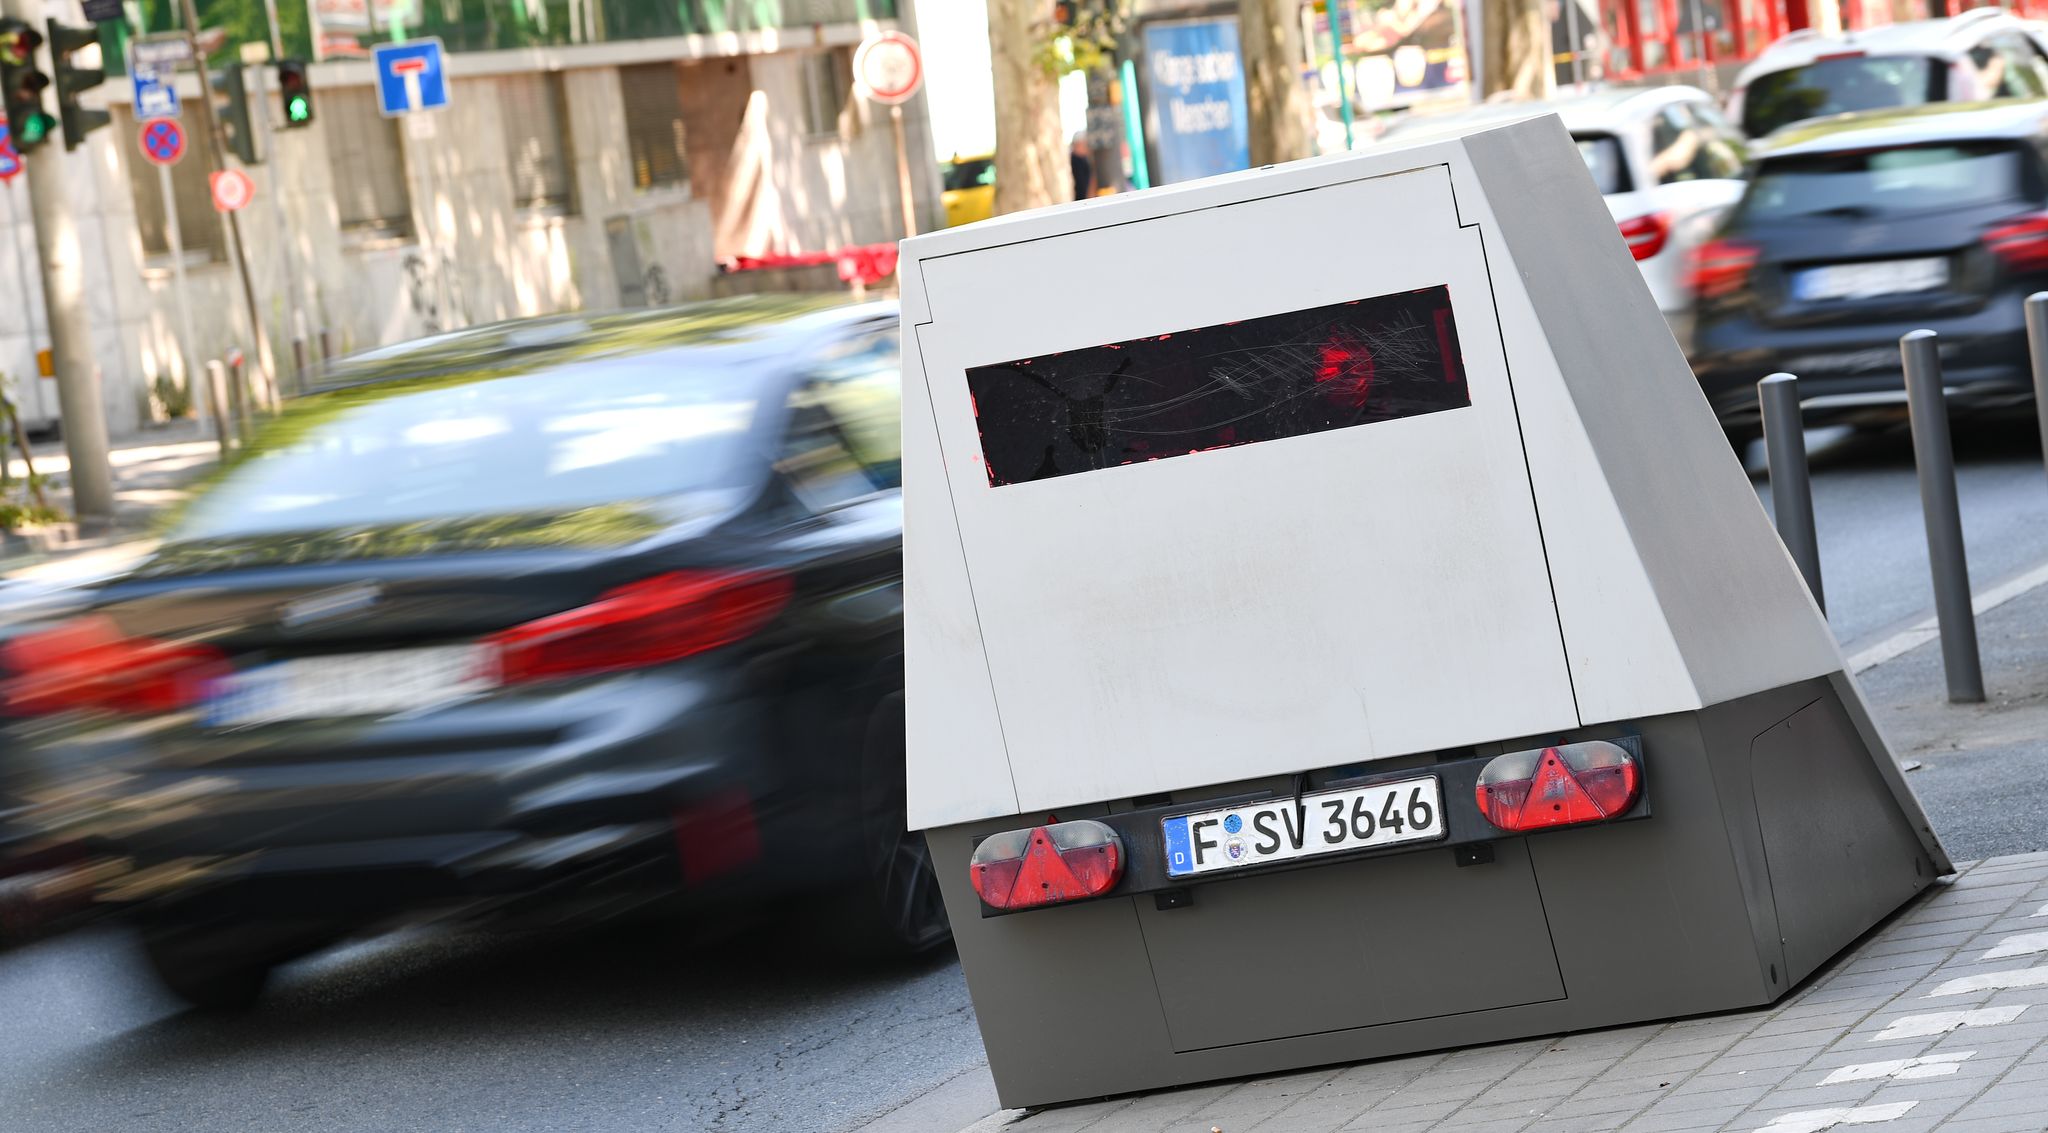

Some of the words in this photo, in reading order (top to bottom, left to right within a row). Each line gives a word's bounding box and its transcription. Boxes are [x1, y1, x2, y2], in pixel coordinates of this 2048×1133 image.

[1192, 818, 1219, 865] F
[1253, 805, 1307, 855] SV
[1321, 787, 1434, 844] 3646
[1174, 851, 1185, 866] D
